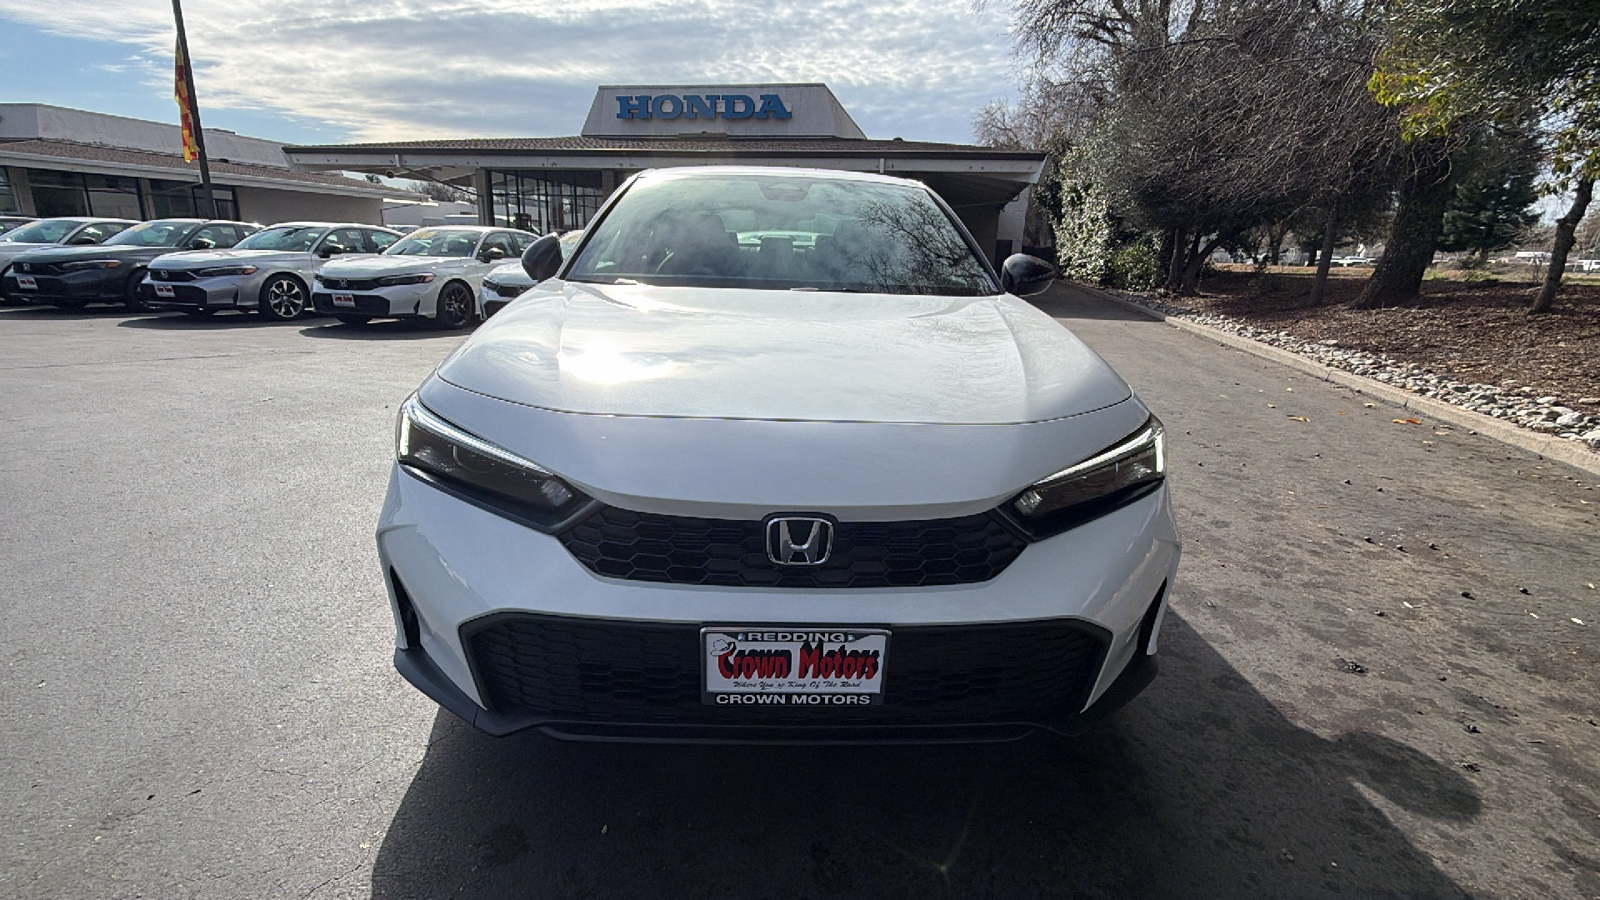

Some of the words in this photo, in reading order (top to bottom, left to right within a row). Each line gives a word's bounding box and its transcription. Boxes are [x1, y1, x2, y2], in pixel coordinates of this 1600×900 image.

[616, 94, 792, 120] HONDA
[748, 633, 845, 642] REDDING
[717, 643, 792, 679] Crown
[798, 641, 880, 679] Motors
[788, 681, 807, 689] King
[716, 695, 786, 704] CROWN
[792, 695, 871, 704] MOTORS
